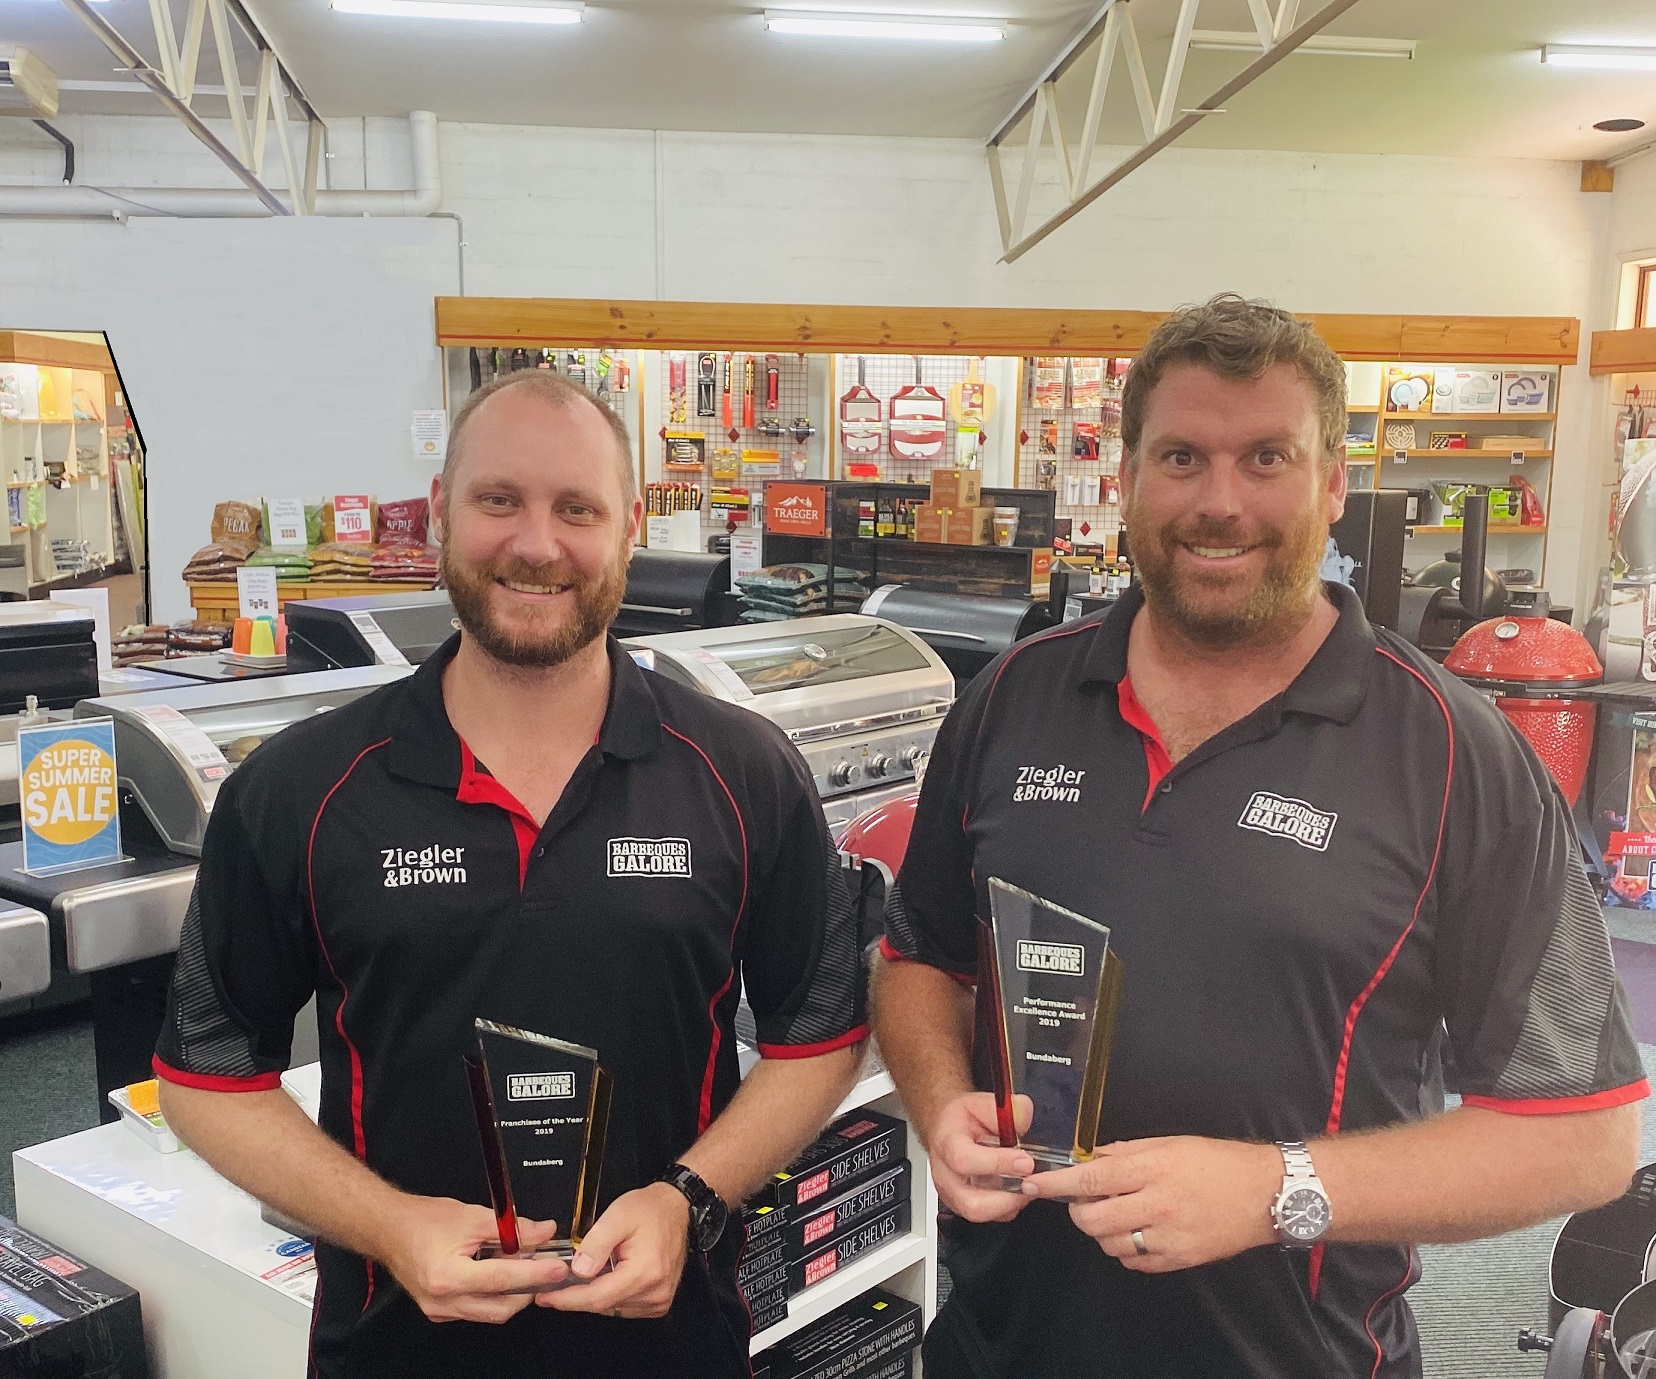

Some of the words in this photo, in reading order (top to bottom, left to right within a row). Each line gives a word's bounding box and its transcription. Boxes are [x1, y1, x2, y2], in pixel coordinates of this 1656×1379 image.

[341, 517, 362, 530] $110
[773, 507, 818, 520] TRAEGER
[40, 748, 101, 769] SUPER
[28, 767, 112, 789] SUMMER
[1016, 764, 1086, 787] Ziegler
[1012, 784, 1080, 803] &Brown
[26, 786, 112, 827] SALE
[1251, 795, 1330, 829] BARBEQUES
[1246, 807, 1326, 845] GALORE
[380, 843, 465, 868] Ziegler
[612, 842, 687, 857] BARBEQUES
[1622, 845, 1649, 854] ABOUT
[613, 855, 687, 873] GALORE
[383, 867, 466, 888] &Brown
[1020, 943, 1080, 959] BARBEQUES
[1020, 953, 1080, 972] GALORE
[1013, 1005, 1057, 1018] Excellence
[1058, 1010, 1086, 1021] Award
[1023, 996, 1077, 1010] Performance
[1038, 1017, 1061, 1027] 2019
[1026, 1051, 1072, 1066] Bundaberg
[511, 1074, 571, 1087] BARBEQUES
[511, 1083, 571, 1098] GALORE
[500, 1118, 541, 1127] Franchisee
[542, 1117, 550, 1125] of
[552, 1117, 565, 1125] the
[566, 1116, 584, 1124] Year
[534, 1127, 554, 1136] 2019
[523, 1159, 564, 1167] Bundaberg
[831, 1159, 851, 1183] SIDE
[853, 1138, 890, 1172] SHELVES
[797, 1172, 829, 1193] Ziegler
[797, 1182, 829, 1203] &Brown
[837, 1198, 856, 1222] SIDE
[858, 1178, 895, 1211] SHELVES
[753, 1209, 786, 1232] HOTPLATE
[804, 1212, 834, 1235] Ziegler
[804, 1222, 834, 1244] &Brown
[838, 1238, 857, 1262] SIDE
[859, 1215, 895, 1248] SHELVES
[751, 1248, 782, 1271] HOTPLATE
[806, 1251, 836, 1273] Ziegler
[20, 1269, 49, 1287] BAG
[755, 1266, 787, 1289] HOTPLATE
[806, 1263, 837, 1285] &Brown
[825, 1363, 841, 1379] 30cm
[841, 1352, 858, 1370] PIZZA
[858, 1342, 875, 1360] STONE
[874, 1334, 890, 1350] WITH
[890, 1319, 915, 1339] HANDLES
[843, 1365, 856, 1377] Grills
[856, 1360, 866, 1370] and
[866, 1354, 878, 1364] most
[878, 1347, 891, 1357] other
[892, 1332, 916, 1349] barbeques
[879, 1358, 905, 1378] HANDLES
